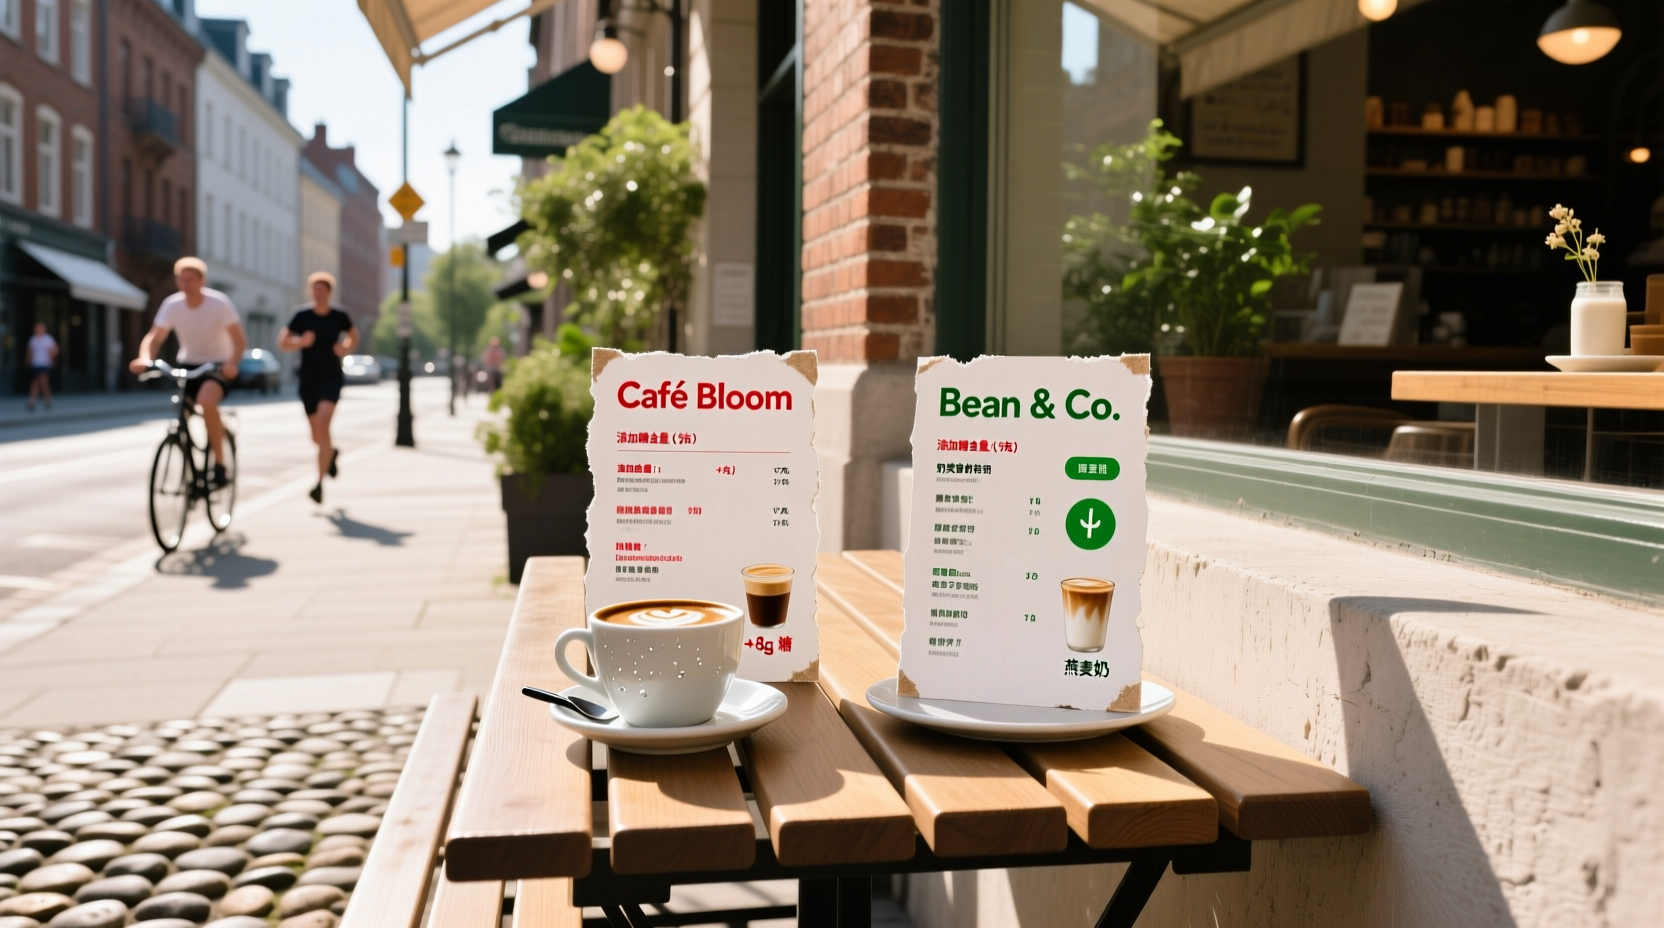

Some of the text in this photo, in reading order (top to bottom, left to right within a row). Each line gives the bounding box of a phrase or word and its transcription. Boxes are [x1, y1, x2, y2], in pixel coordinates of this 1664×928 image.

[617, 380, 792, 411] Café Bloom
[940, 388, 1120, 421] Bean & Co.
[744, 636, 773, 656] +8g
[1065, 658, 1109, 678] 燕麦奶
